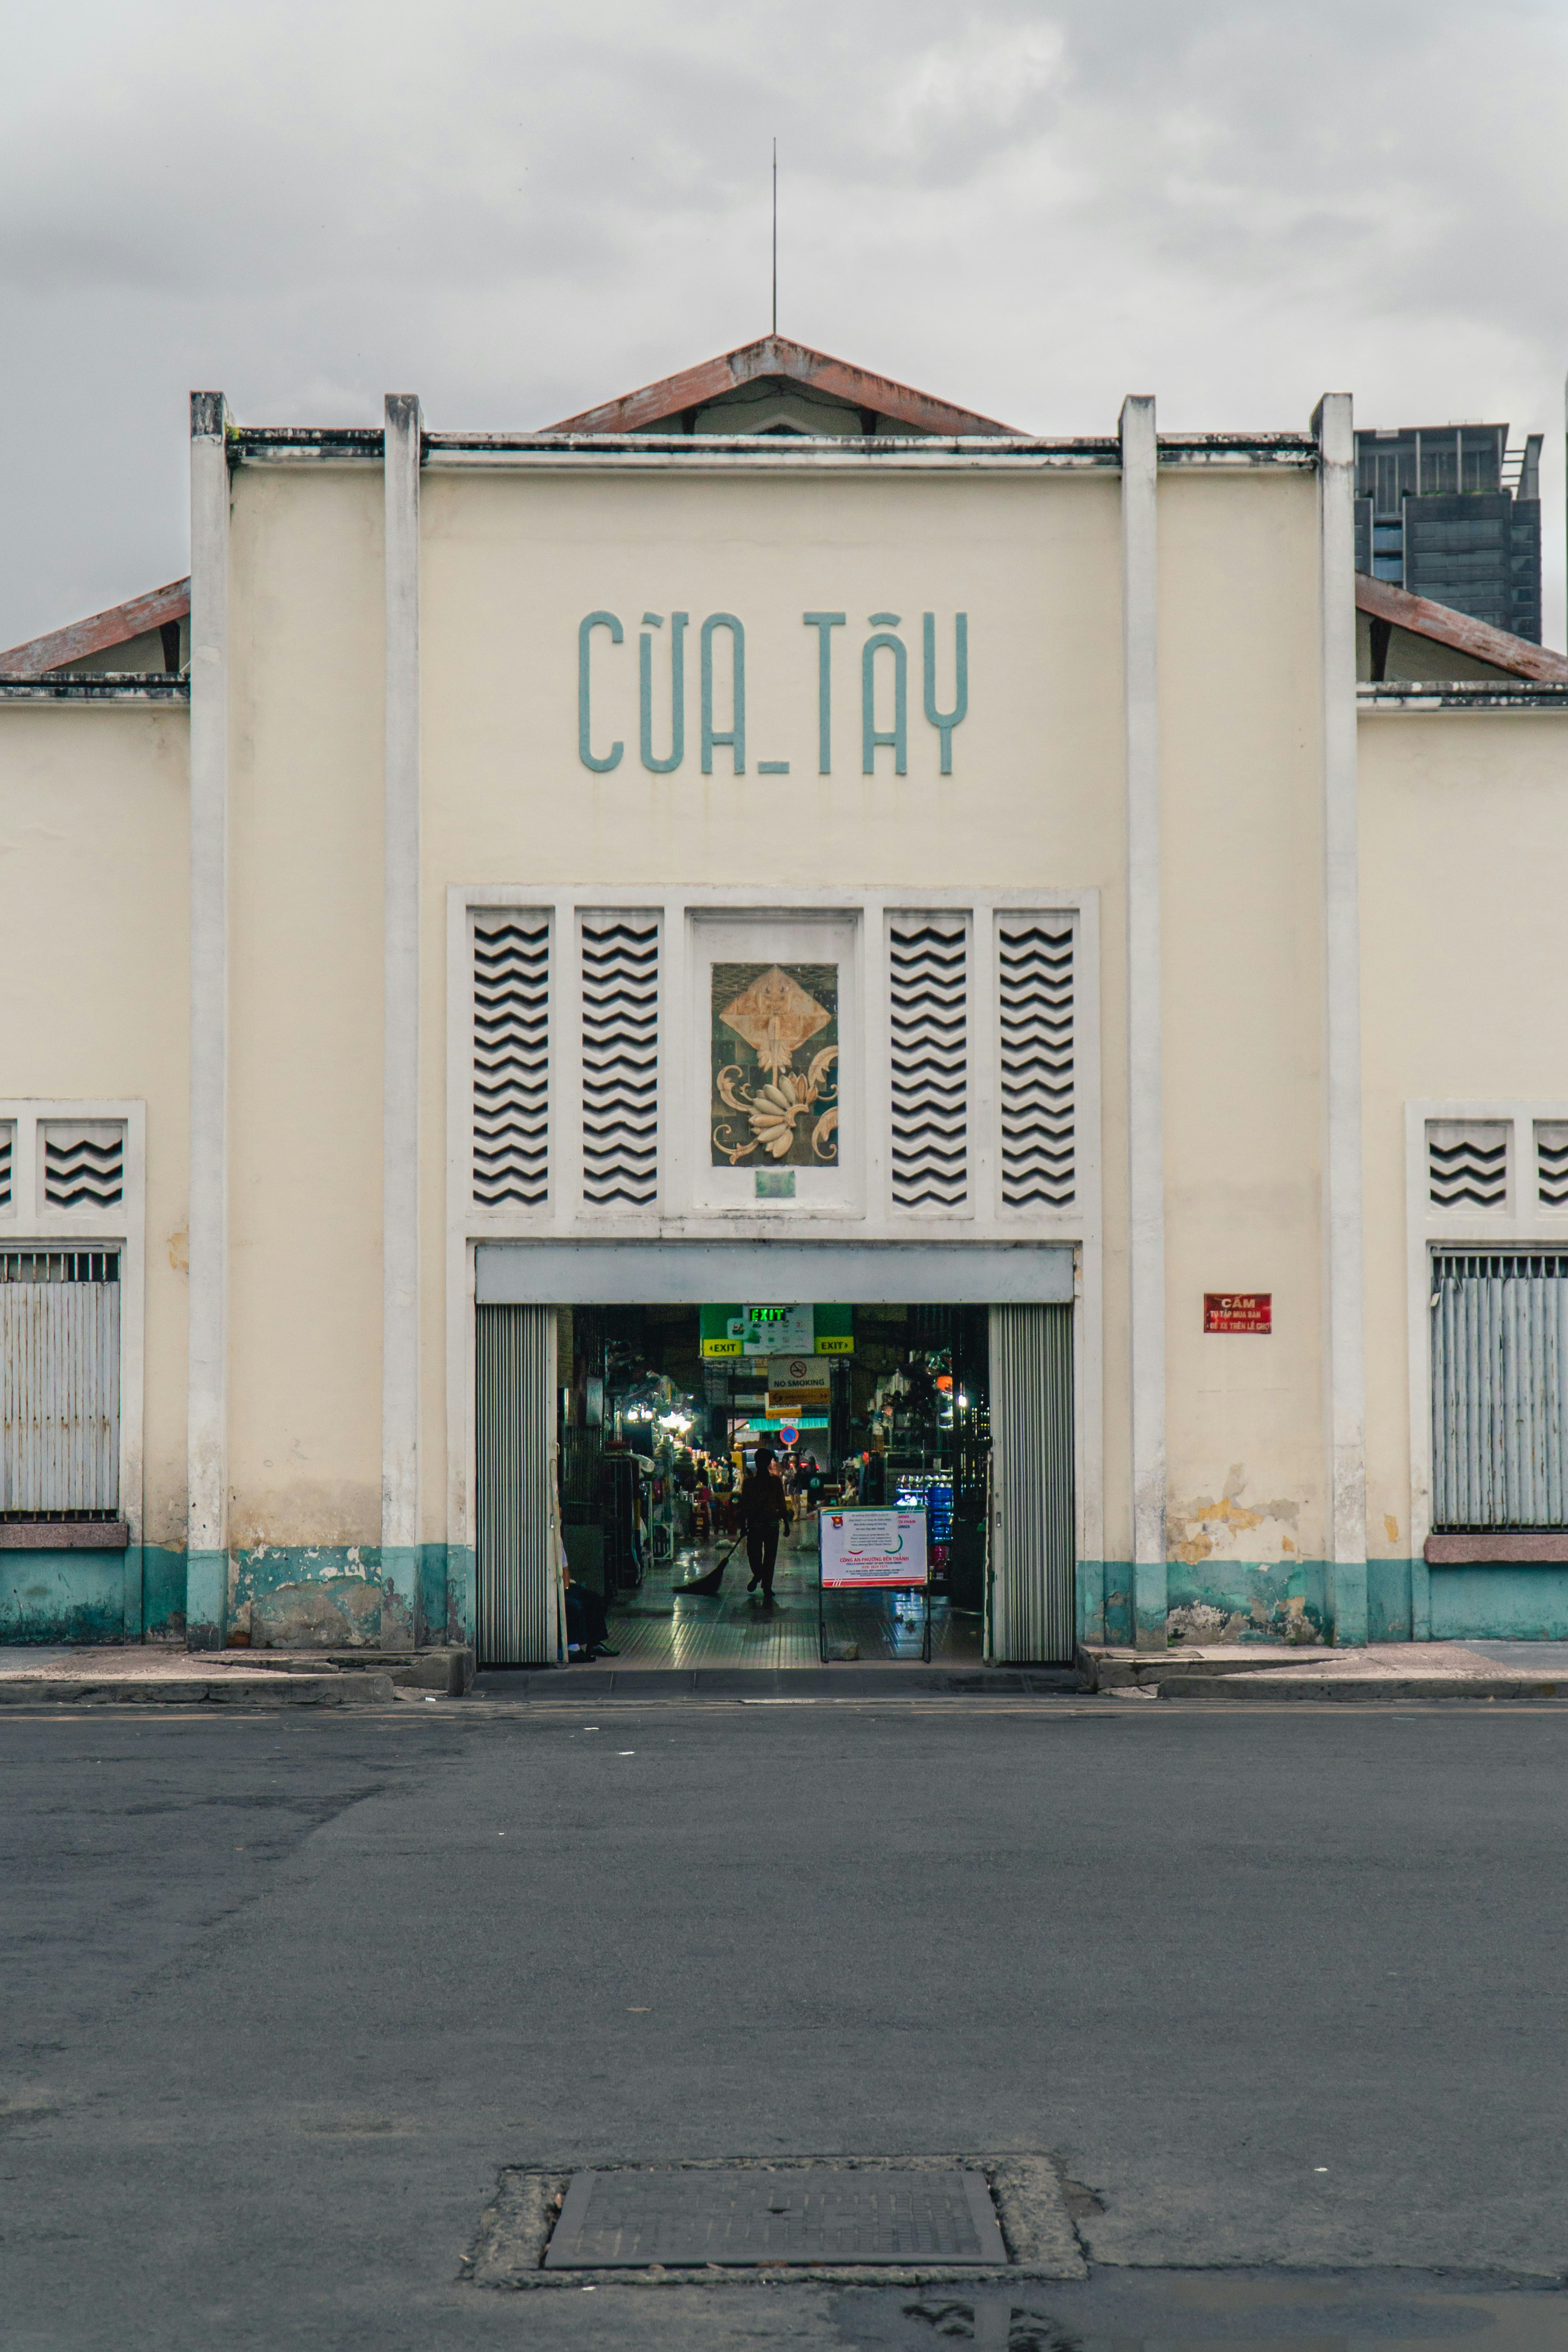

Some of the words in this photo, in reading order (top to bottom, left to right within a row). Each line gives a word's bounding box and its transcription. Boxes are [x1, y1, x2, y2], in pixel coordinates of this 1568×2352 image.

[1222, 1295, 1256, 1308] CẤM
[752, 1309, 784, 1320] EXIT
[1233, 1310, 1247, 1318] MUA
[1229, 1321, 1246, 1330] TRÊN
[714, 1344, 736, 1352] EXIT
[788, 1379, 824, 1387] SMOKING
